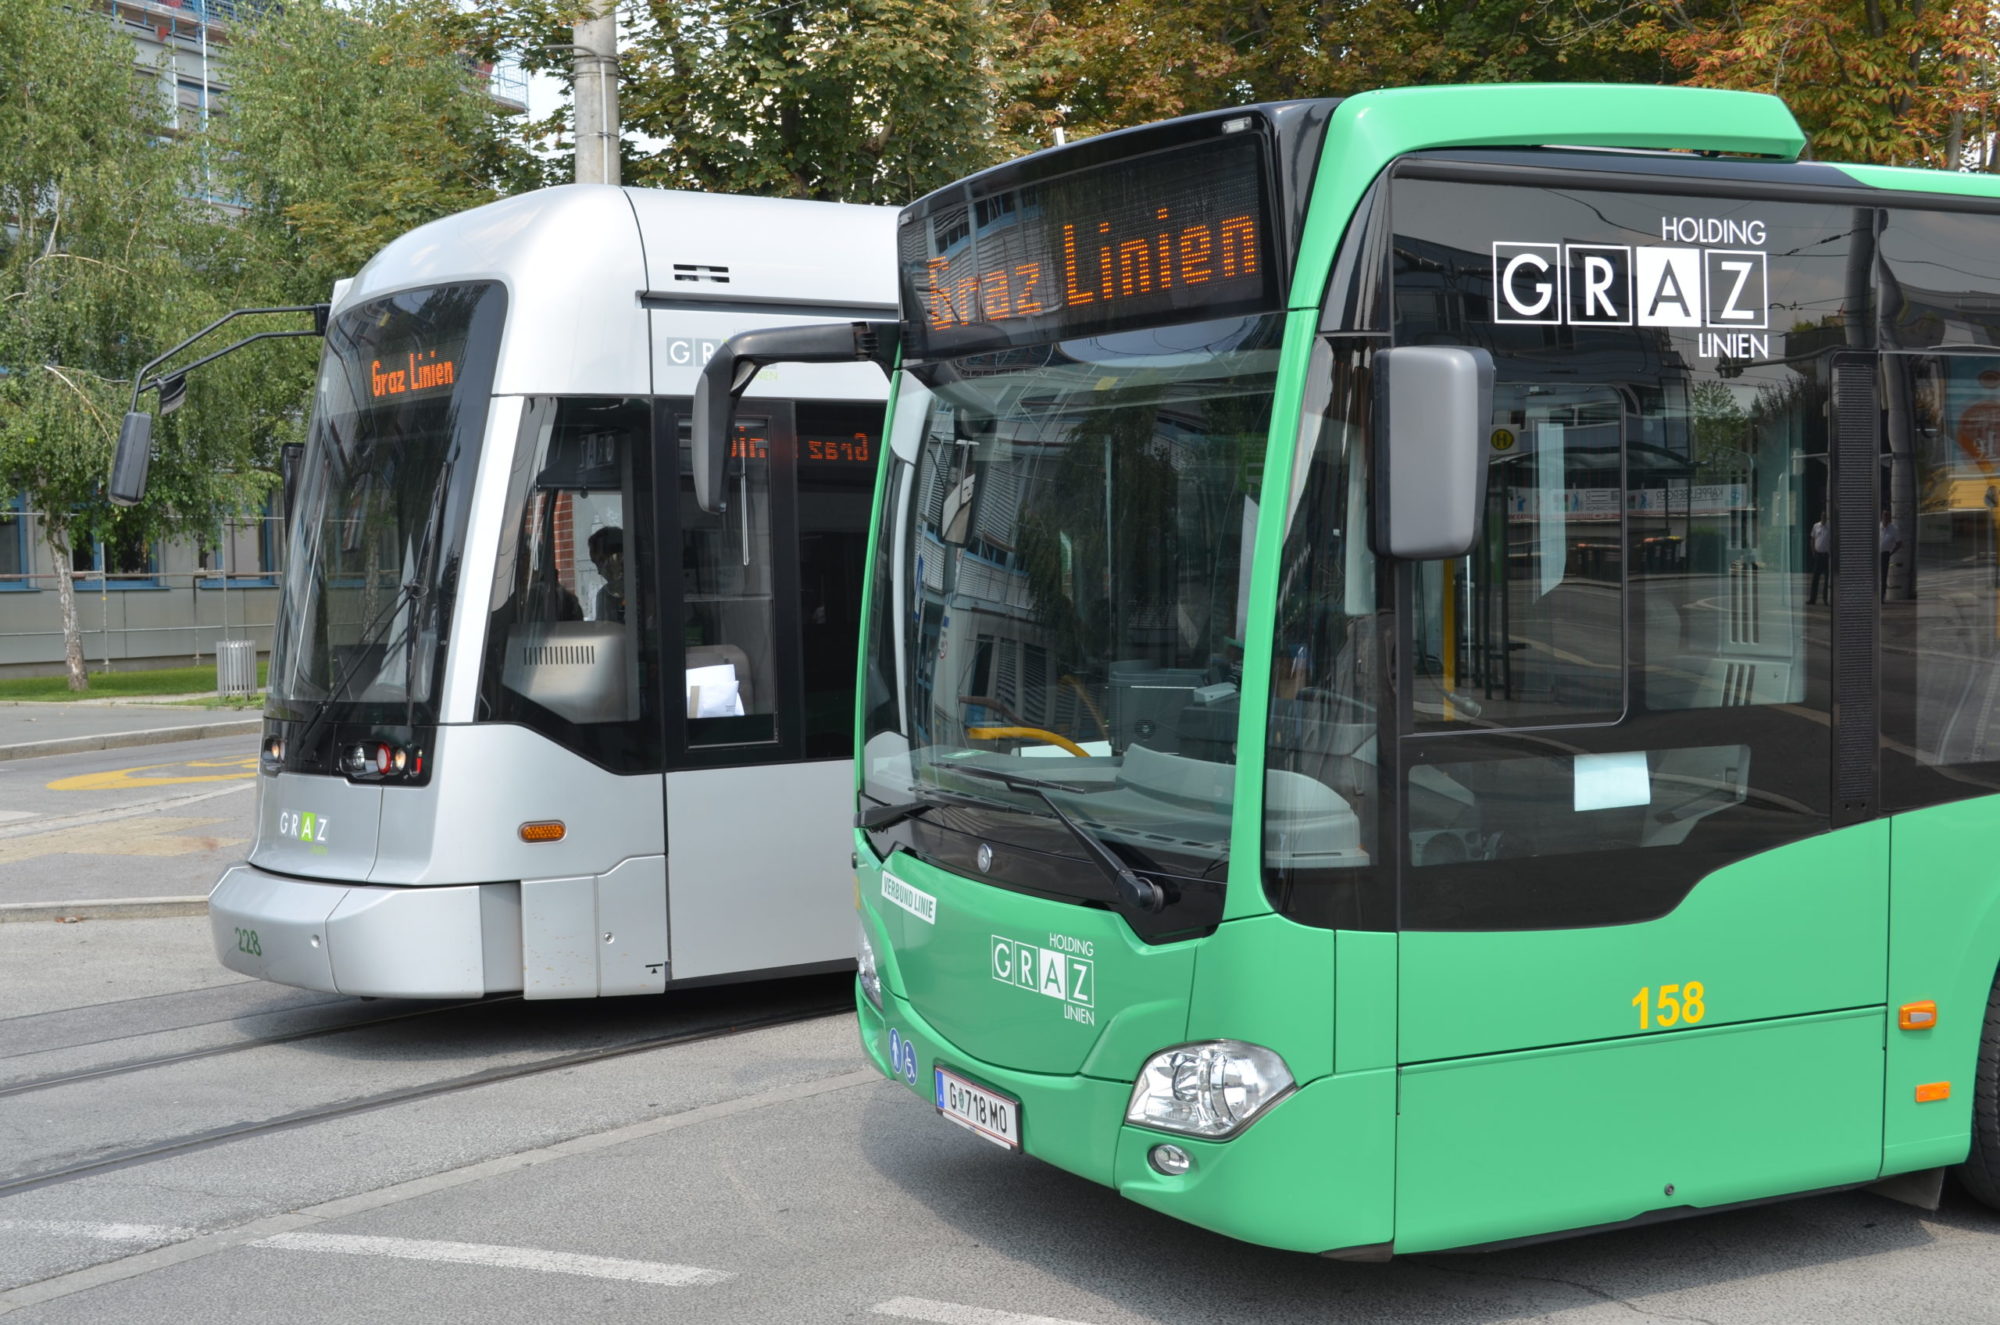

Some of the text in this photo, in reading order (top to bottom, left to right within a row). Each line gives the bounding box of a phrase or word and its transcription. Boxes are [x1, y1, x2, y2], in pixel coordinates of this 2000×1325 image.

[1662, 217, 1767, 246] HOLDING
[928, 207, 1256, 331] Graz Linien
[1501, 249, 1757, 321] GRAZ
[1699, 332, 1769, 360] LINIEN
[372, 350, 454, 397] Graz Linien
[280, 811, 328, 841] GRAZ
[884, 874, 934, 919] VERBUND LINIE
[235, 926, 262, 957] 228
[1049, 932, 1095, 957] HOLDING
[994, 942, 1089, 1002] GRAZ
[1063, 1003, 1095, 1027] LINIEN
[1631, 980, 1705, 1030] 158
